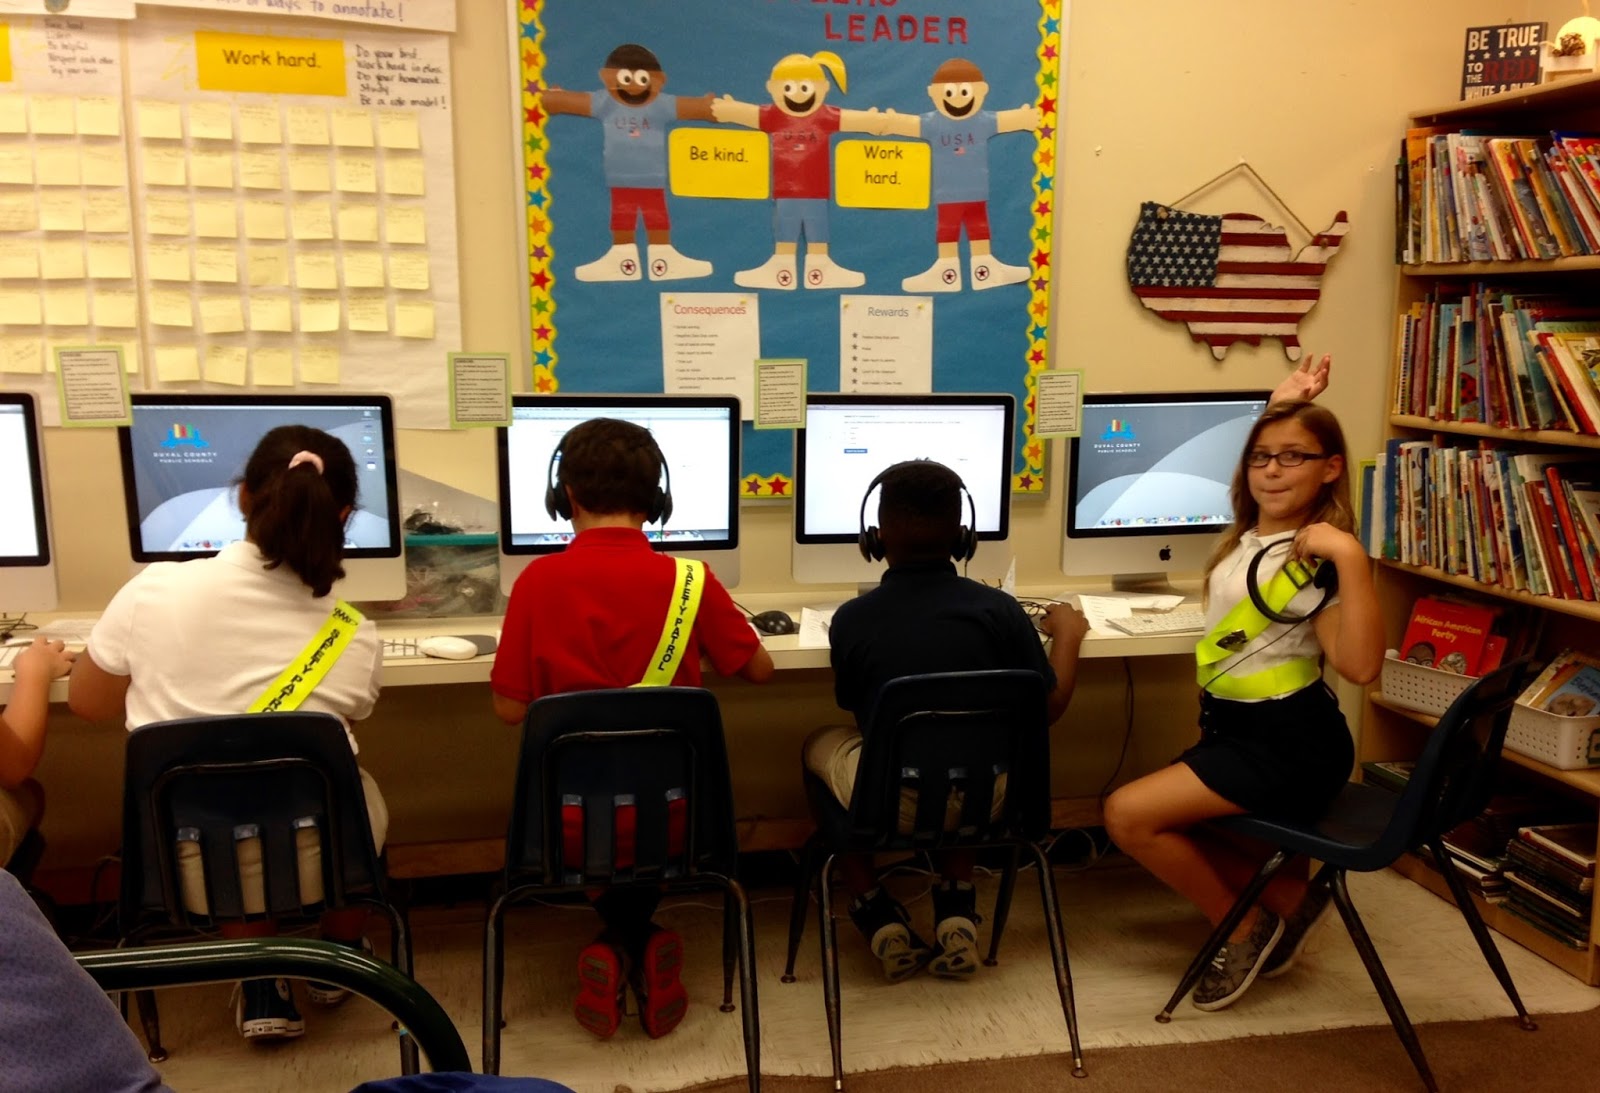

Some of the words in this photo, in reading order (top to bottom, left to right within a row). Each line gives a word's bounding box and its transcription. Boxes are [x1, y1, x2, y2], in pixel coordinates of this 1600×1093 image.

[312, 0, 324, 12] to
[332, 1, 404, 22] annotate!
[824, 13, 968, 44] LEADER
[1468, 31, 1490, 51] BE
[1498, 25, 1540, 48] TRUE
[222, 49, 271, 66] Work
[277, 53, 321, 69] hard.
[356, 43, 369, 57] Do
[1467, 62, 1484, 73] TO
[1484, 57, 1537, 82] RED
[1466, 74, 1482, 83] THE
[360, 94, 371, 105] Be
[690, 146, 708, 162] Be
[713, 147, 749, 163] kind.
[864, 145, 903, 160] Work
[864, 170, 902, 185] hard.
[674, 304, 747, 316] Consequences
[868, 306, 909, 318] Rewards
[679, 564, 693, 616] SAFETY
[1414, 614, 1443, 627] African
[1444, 620, 1482, 635] American
[301, 628, 340, 675] SAFETY
[658, 617, 682, 671] PATROL
